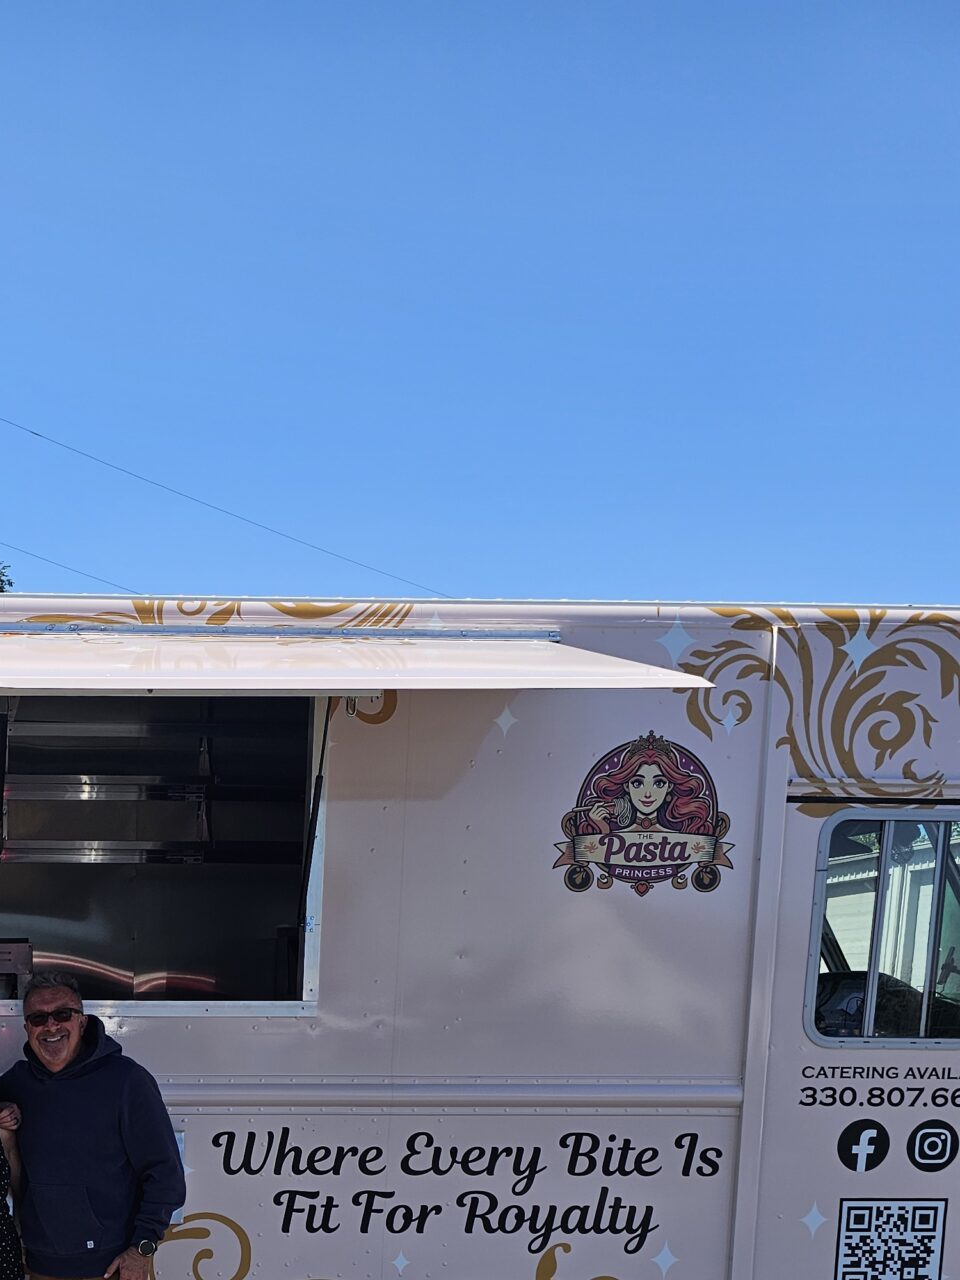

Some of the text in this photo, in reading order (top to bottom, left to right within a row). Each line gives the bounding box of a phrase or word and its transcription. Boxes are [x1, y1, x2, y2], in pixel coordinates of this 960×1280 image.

[598, 832, 691, 863] Pasta
[615, 867, 673, 878] PRINCESS
[801, 1065, 960, 1080] CATERING AVAIL
[211, 1127, 723, 1197] Where Every Bite Is
[272, 1186, 660, 1255] Fit For Royalty
